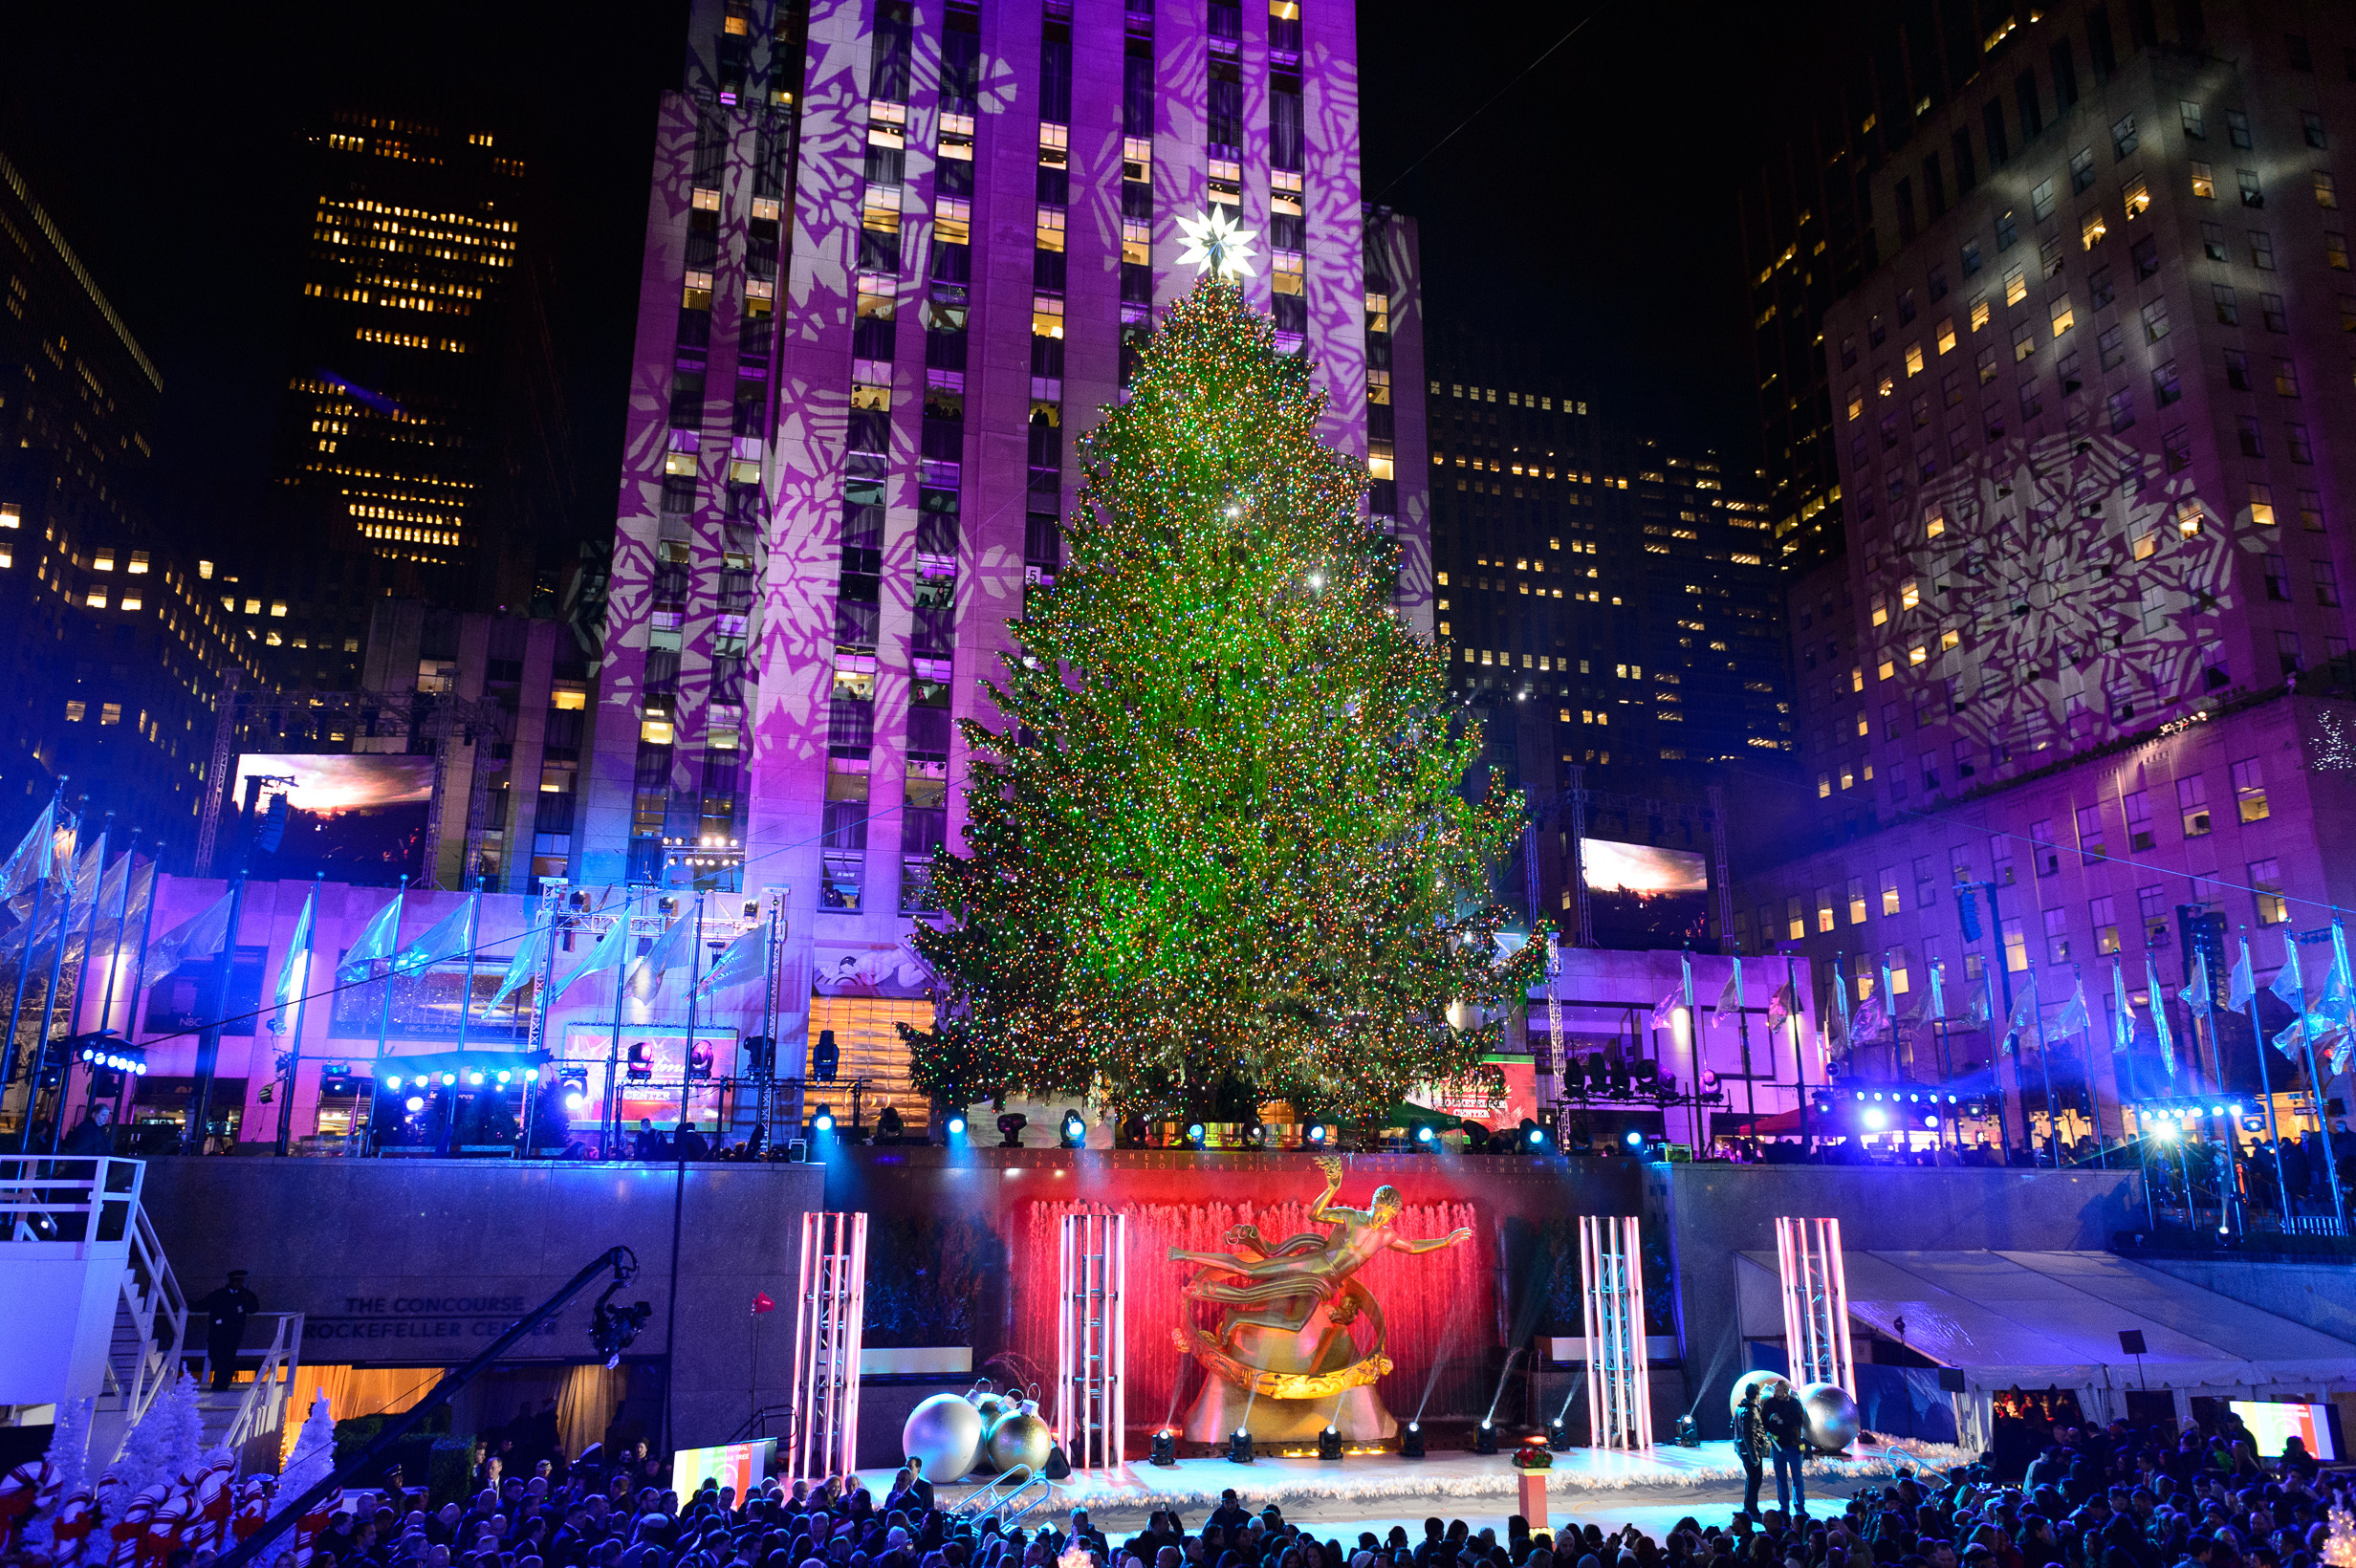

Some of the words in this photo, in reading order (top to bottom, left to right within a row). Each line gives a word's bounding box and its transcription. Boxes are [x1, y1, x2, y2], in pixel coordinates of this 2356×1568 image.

[1030, 570, 1036, 582] 5
[179, 1017, 203, 1027] NBC
[404, 1024, 421, 1033] NBC
[423, 1024, 444, 1034] Studio
[446, 1025, 459, 1034] Tour
[623, 1090, 671, 1100] CENTER
[1452, 1109, 1491, 1119] CENTER
[1065, 1152, 1166, 1161] TEACHER
[1034, 1160, 1118, 1169] PROVED
[1141, 1162, 1165, 1170] TO
[1187, 1163, 1282, 1171] MORTALS
[345, 1296, 386, 1314] THE
[393, 1296, 526, 1314] CONCOURSE
[304, 1322, 461, 1339] ROCKEFELLER
[472, 1321, 557, 1337] CEER
